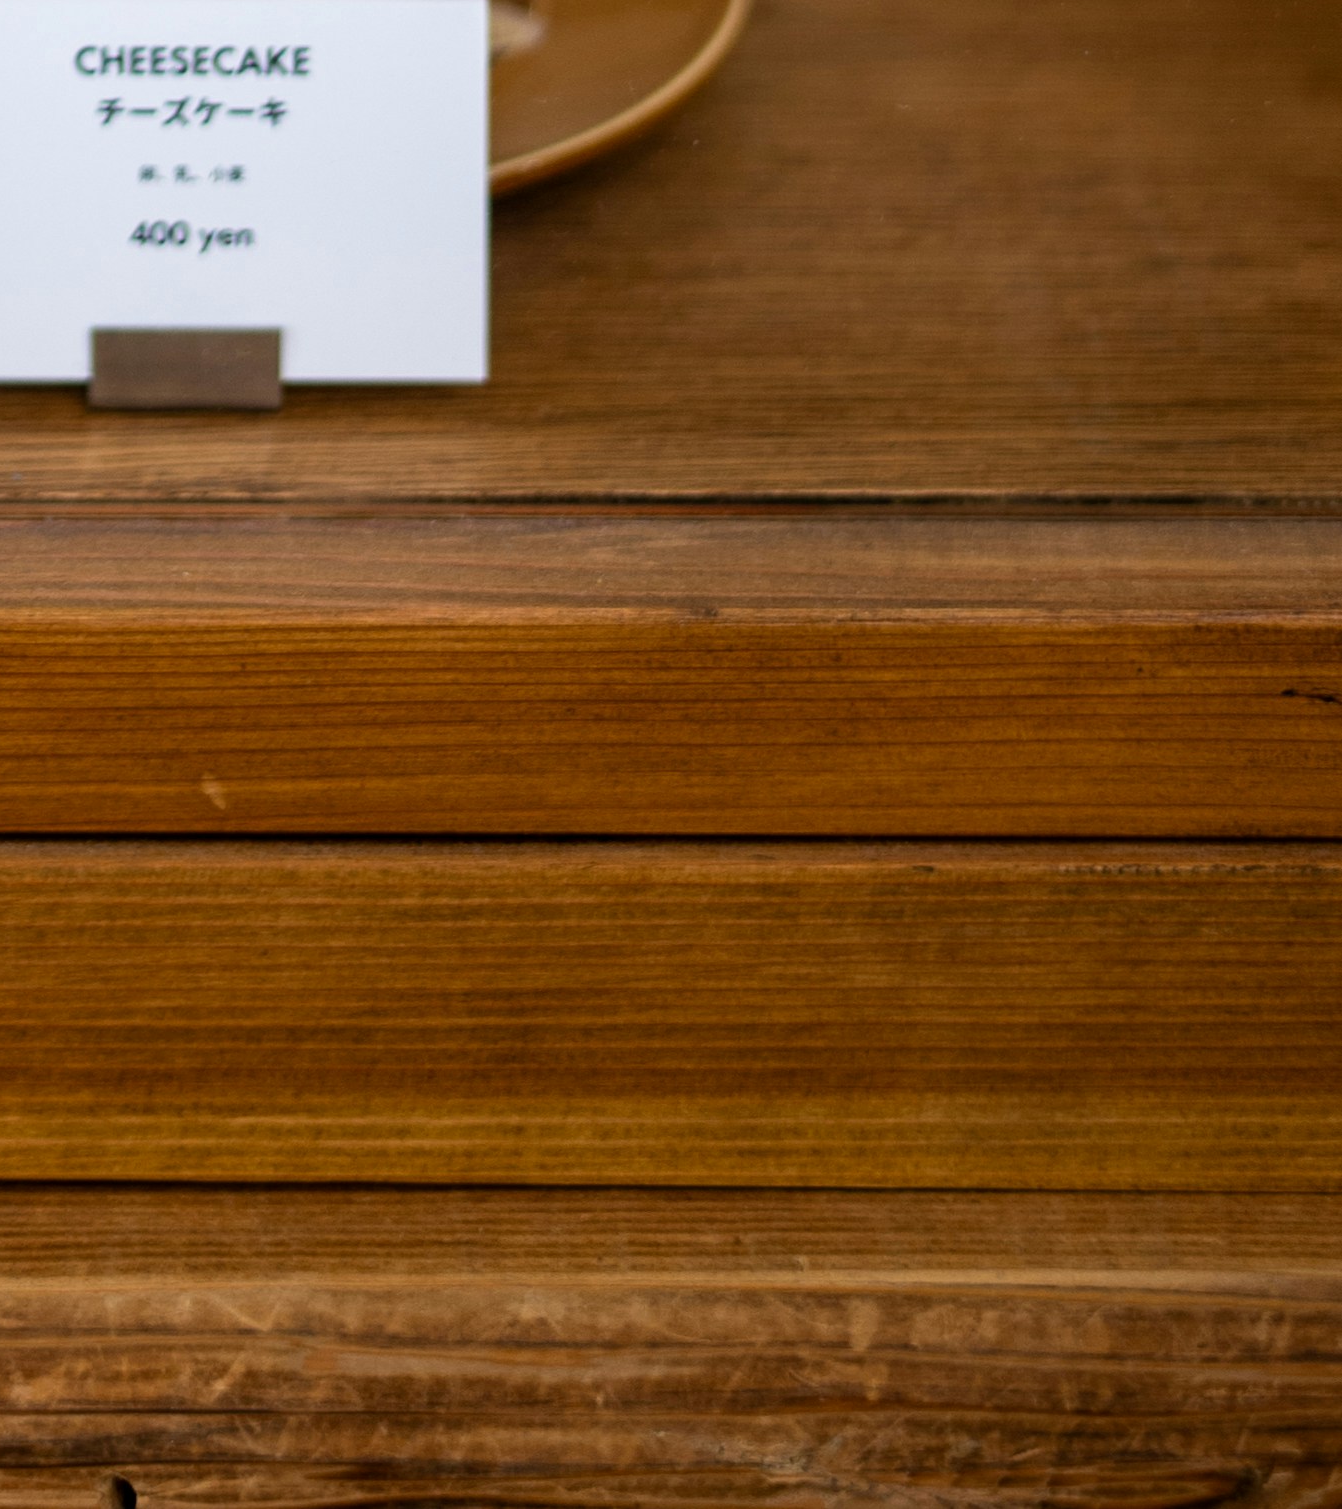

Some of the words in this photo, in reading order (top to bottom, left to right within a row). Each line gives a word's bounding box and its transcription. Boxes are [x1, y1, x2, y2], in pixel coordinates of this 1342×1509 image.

[75, 46, 309, 76] CHEESECAKE
[98, 97, 287, 126] チーズケーキ
[128, 219, 191, 247] 400
[197, 226, 255, 254] yen
